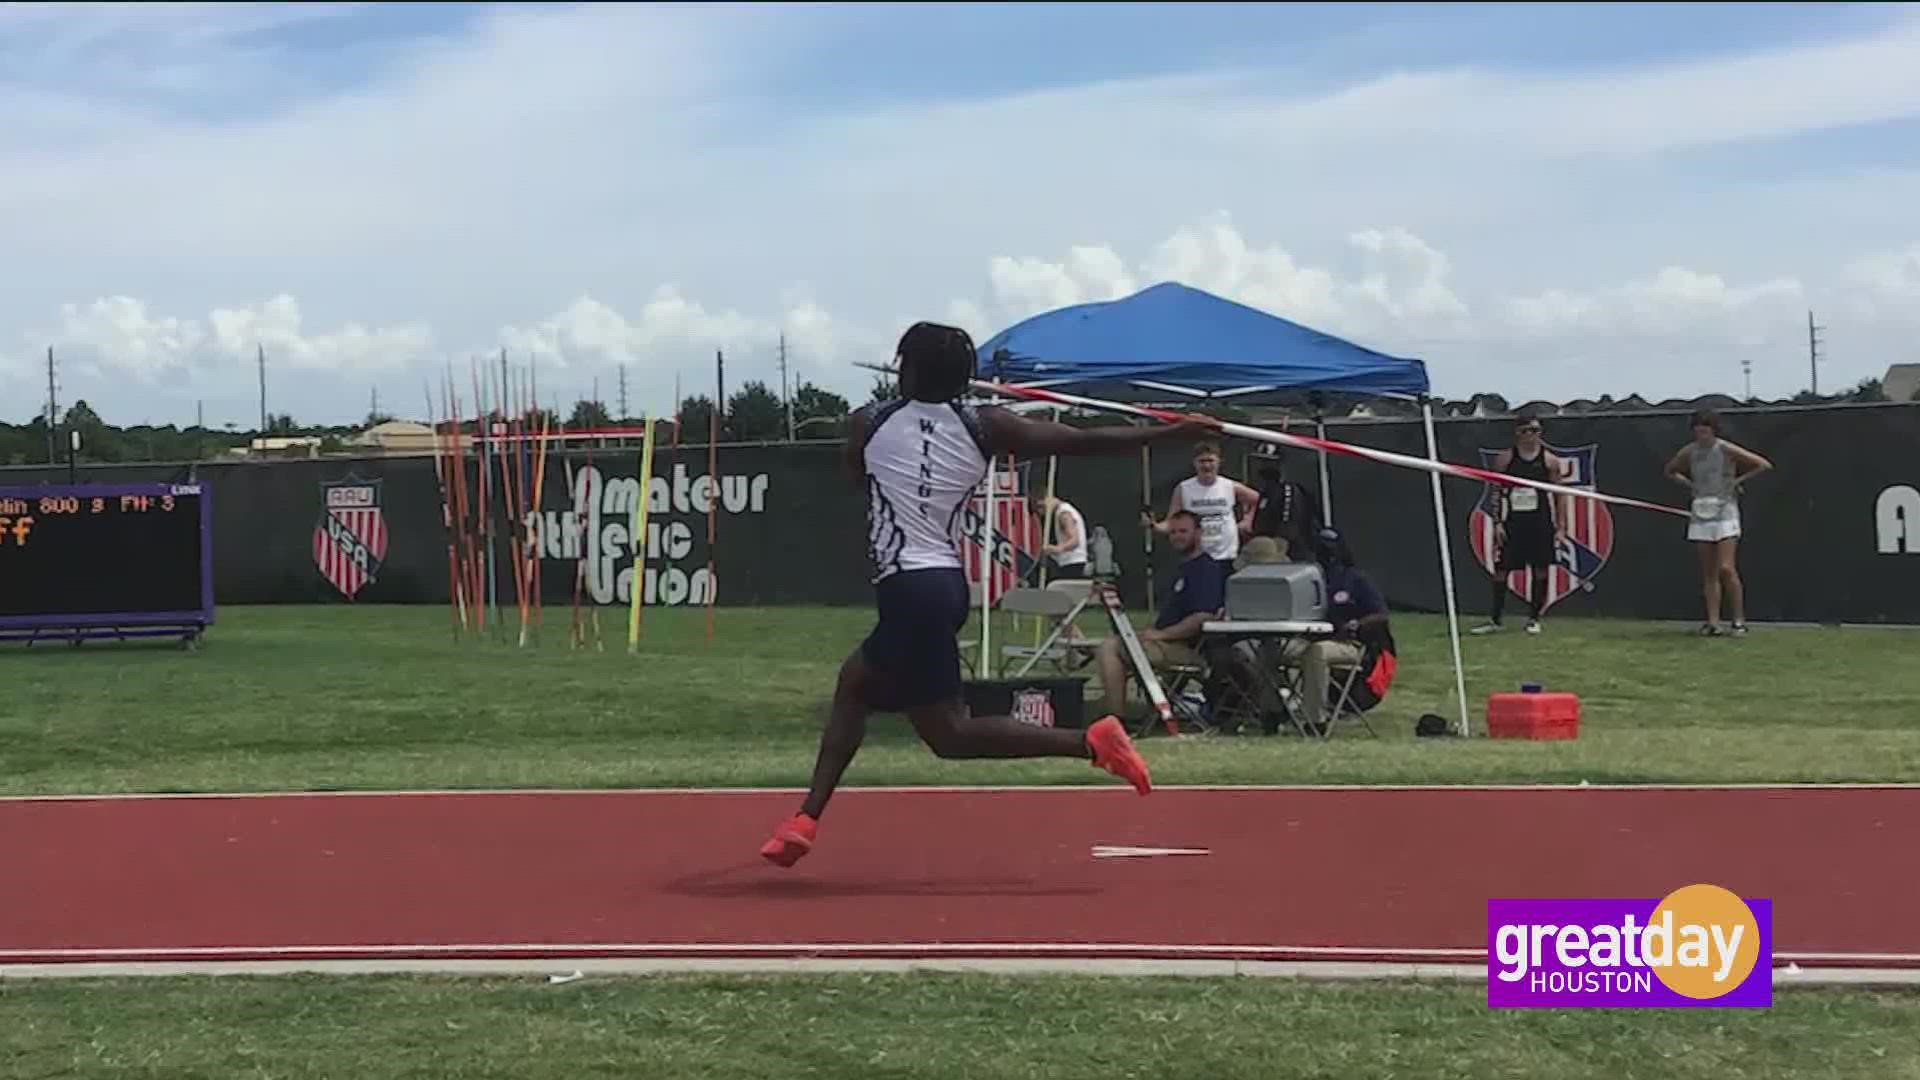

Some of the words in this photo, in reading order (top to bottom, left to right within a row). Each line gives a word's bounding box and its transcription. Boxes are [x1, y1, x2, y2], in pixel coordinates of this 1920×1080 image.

[39, 496, 79, 514] 800
[160, 495, 175, 512] 3
[330, 490, 369, 503] AAU
[576, 463, 769, 514] Amateur
[328, 515, 367, 571] USA
